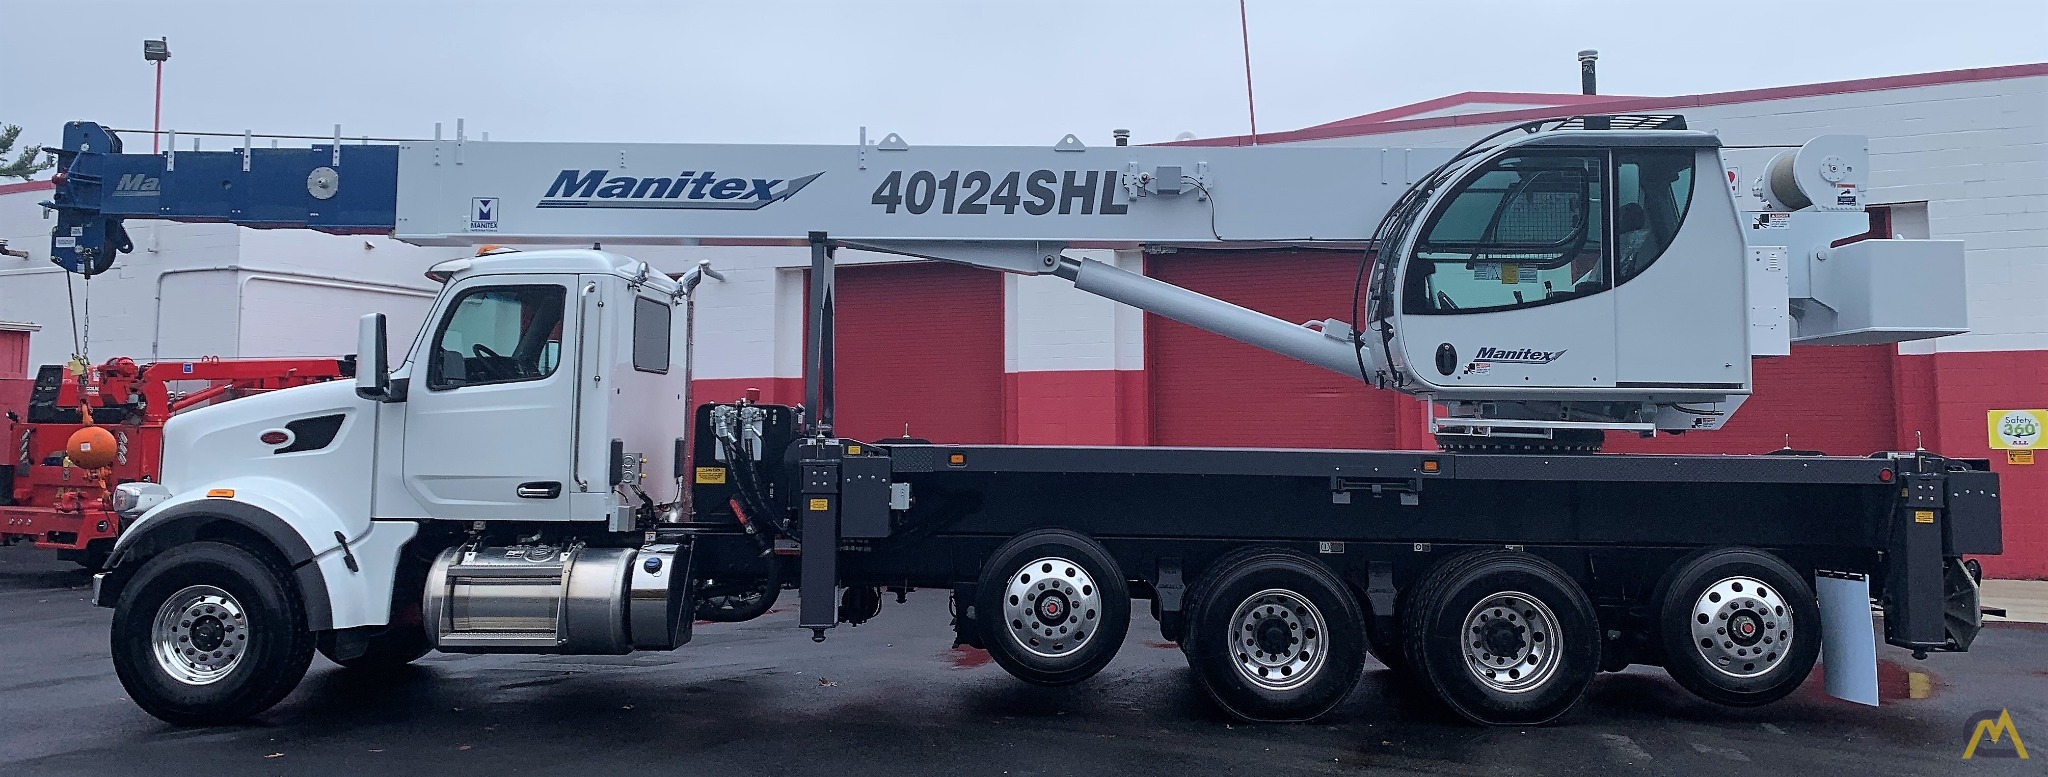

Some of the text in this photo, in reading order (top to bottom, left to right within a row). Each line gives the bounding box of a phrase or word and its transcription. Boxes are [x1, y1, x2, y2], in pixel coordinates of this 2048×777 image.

[116, 173, 160, 191] Ma
[544, 169, 784, 200] Manitex
[871, 169, 1129, 215] 40124SHL
[1475, 346, 1553, 361] Manitex
[2005, 416, 2032, 424] Safety
